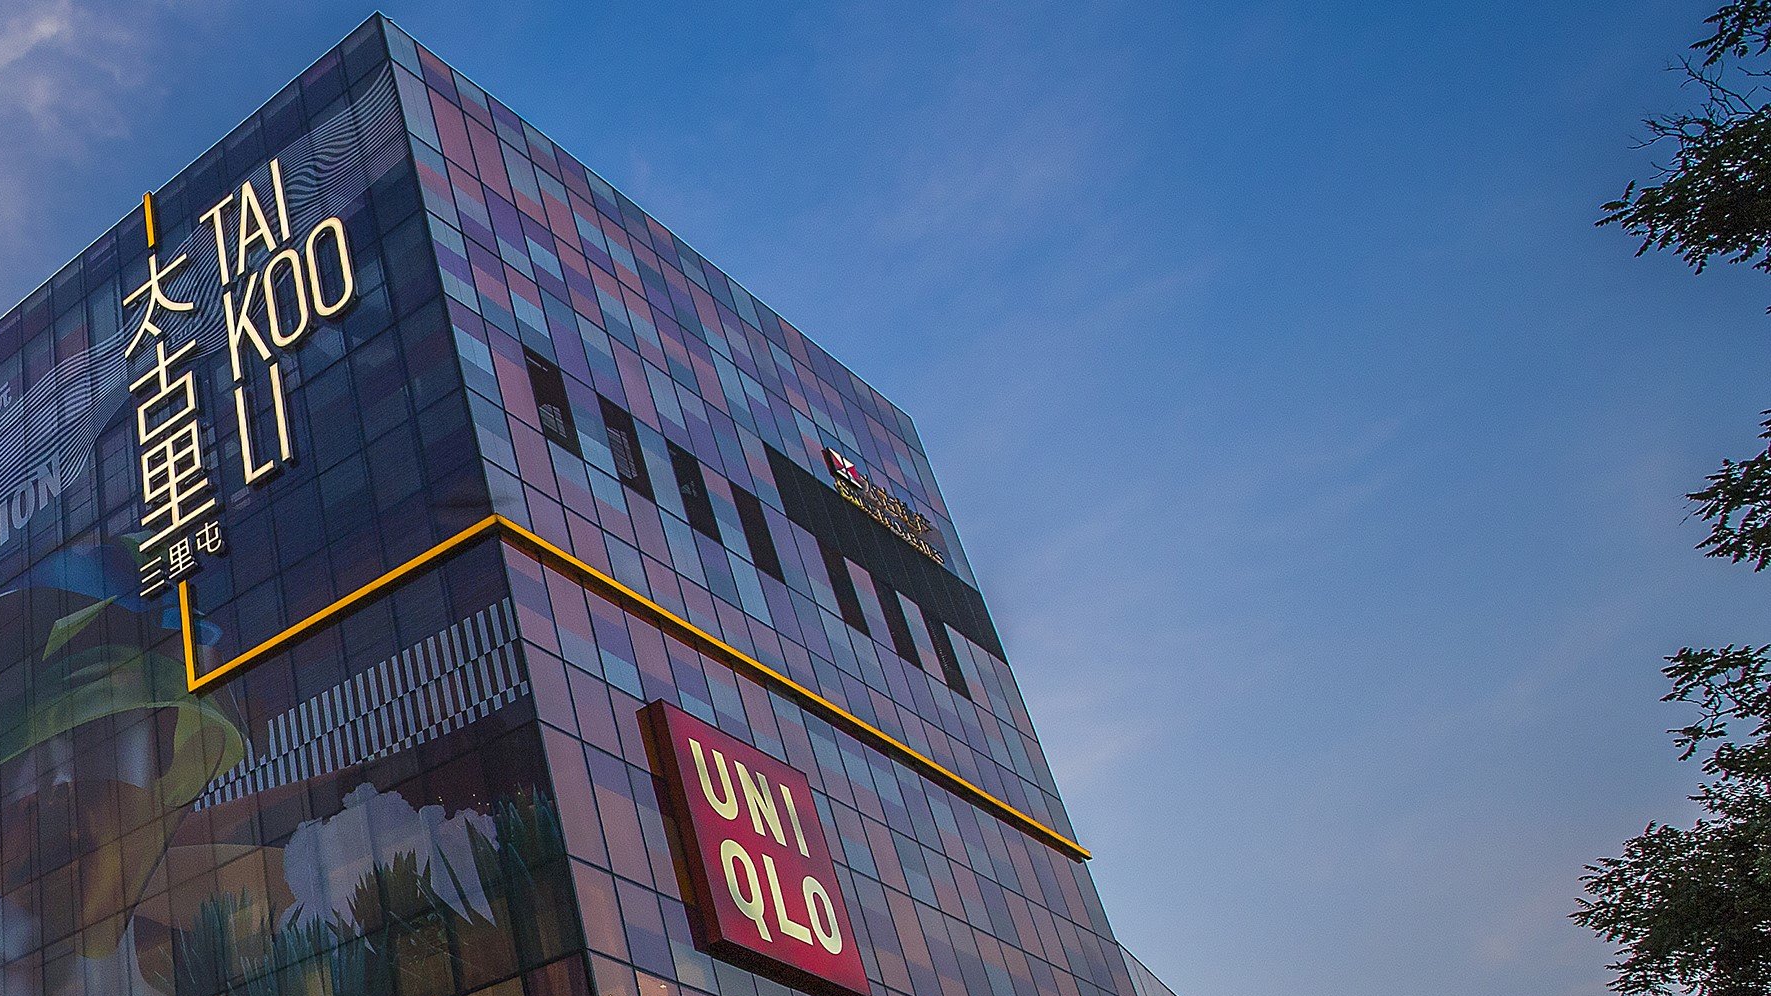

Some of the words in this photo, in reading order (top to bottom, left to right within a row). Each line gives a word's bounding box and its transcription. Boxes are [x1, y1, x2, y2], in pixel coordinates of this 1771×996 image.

[200, 158, 292, 286] TAI
[223, 217, 355, 381] KOO
[123, 253, 216, 552] 太古里
[234, 363, 293, 485] LI
[139, 520, 222, 597] 三里屯
[687, 738, 811, 859] UNI
[718, 839, 844, 956] QLO
